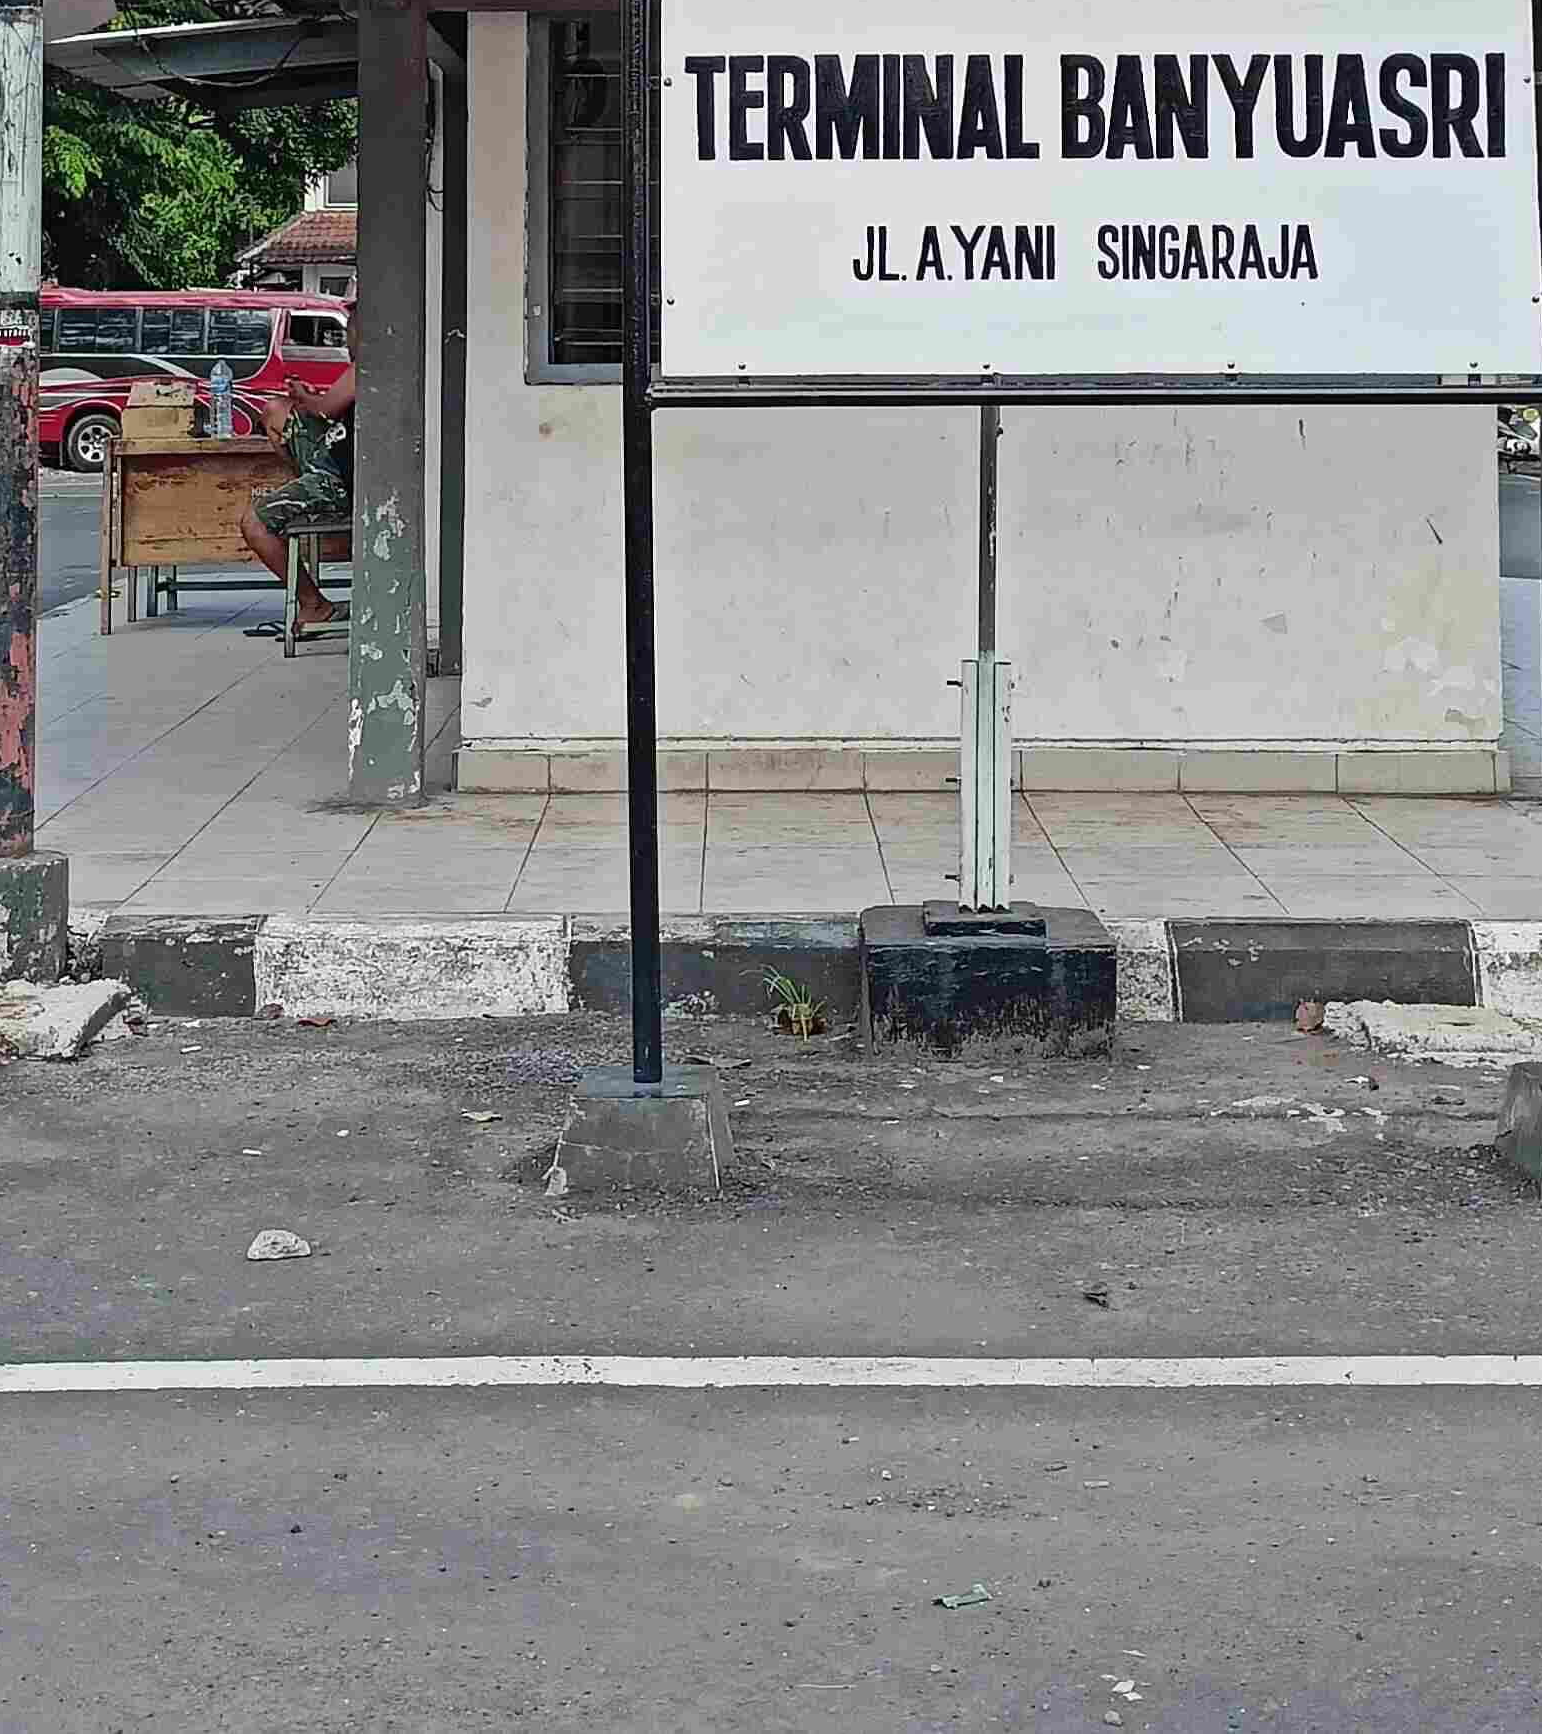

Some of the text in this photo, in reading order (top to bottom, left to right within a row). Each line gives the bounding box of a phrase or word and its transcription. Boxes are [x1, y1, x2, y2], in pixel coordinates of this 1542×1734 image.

[684, 52, 1506, 161] TERMINAL BANYUASRI
[1097, 224, 1319, 280] SINGARAJA
